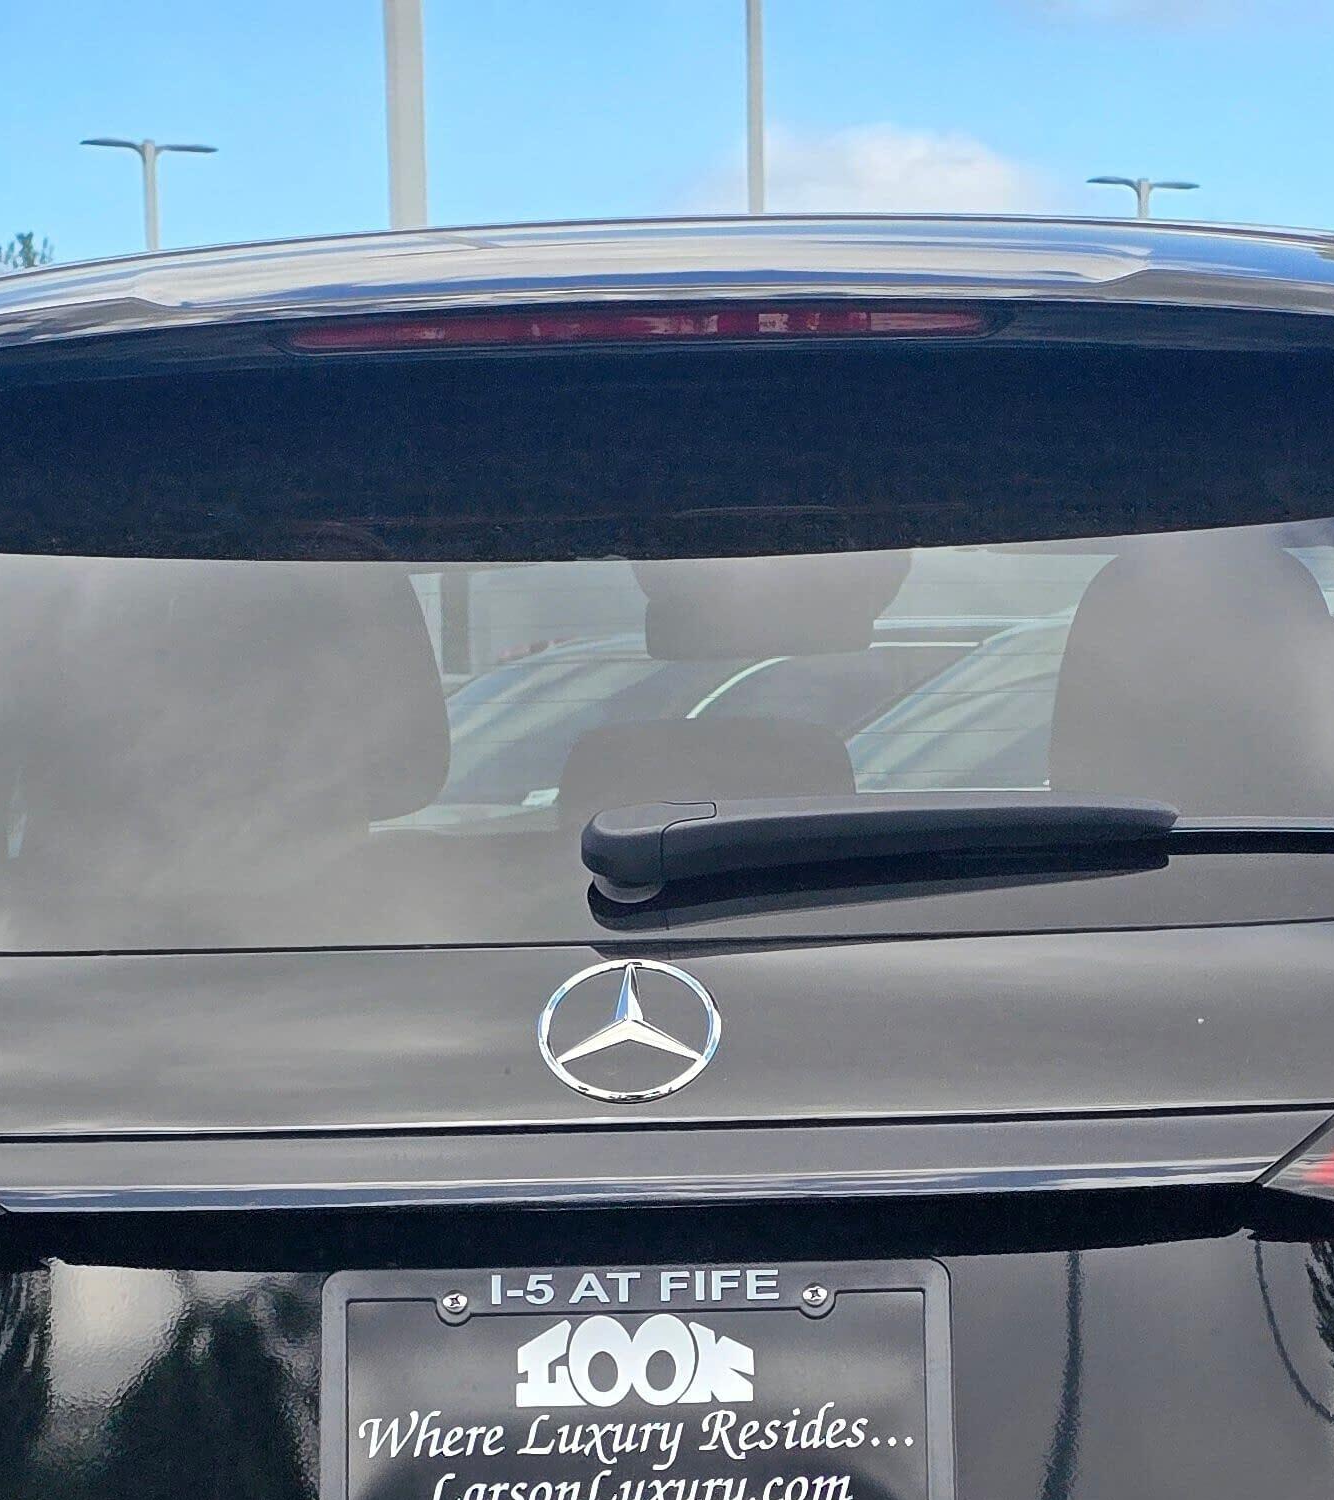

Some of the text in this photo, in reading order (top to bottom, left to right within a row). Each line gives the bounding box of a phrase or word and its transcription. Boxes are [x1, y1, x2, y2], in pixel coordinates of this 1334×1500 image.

[490, 1268, 781, 1306] I-5 AT FIFE
[357, 1400, 915, 1472] Where Luxury Resides...
